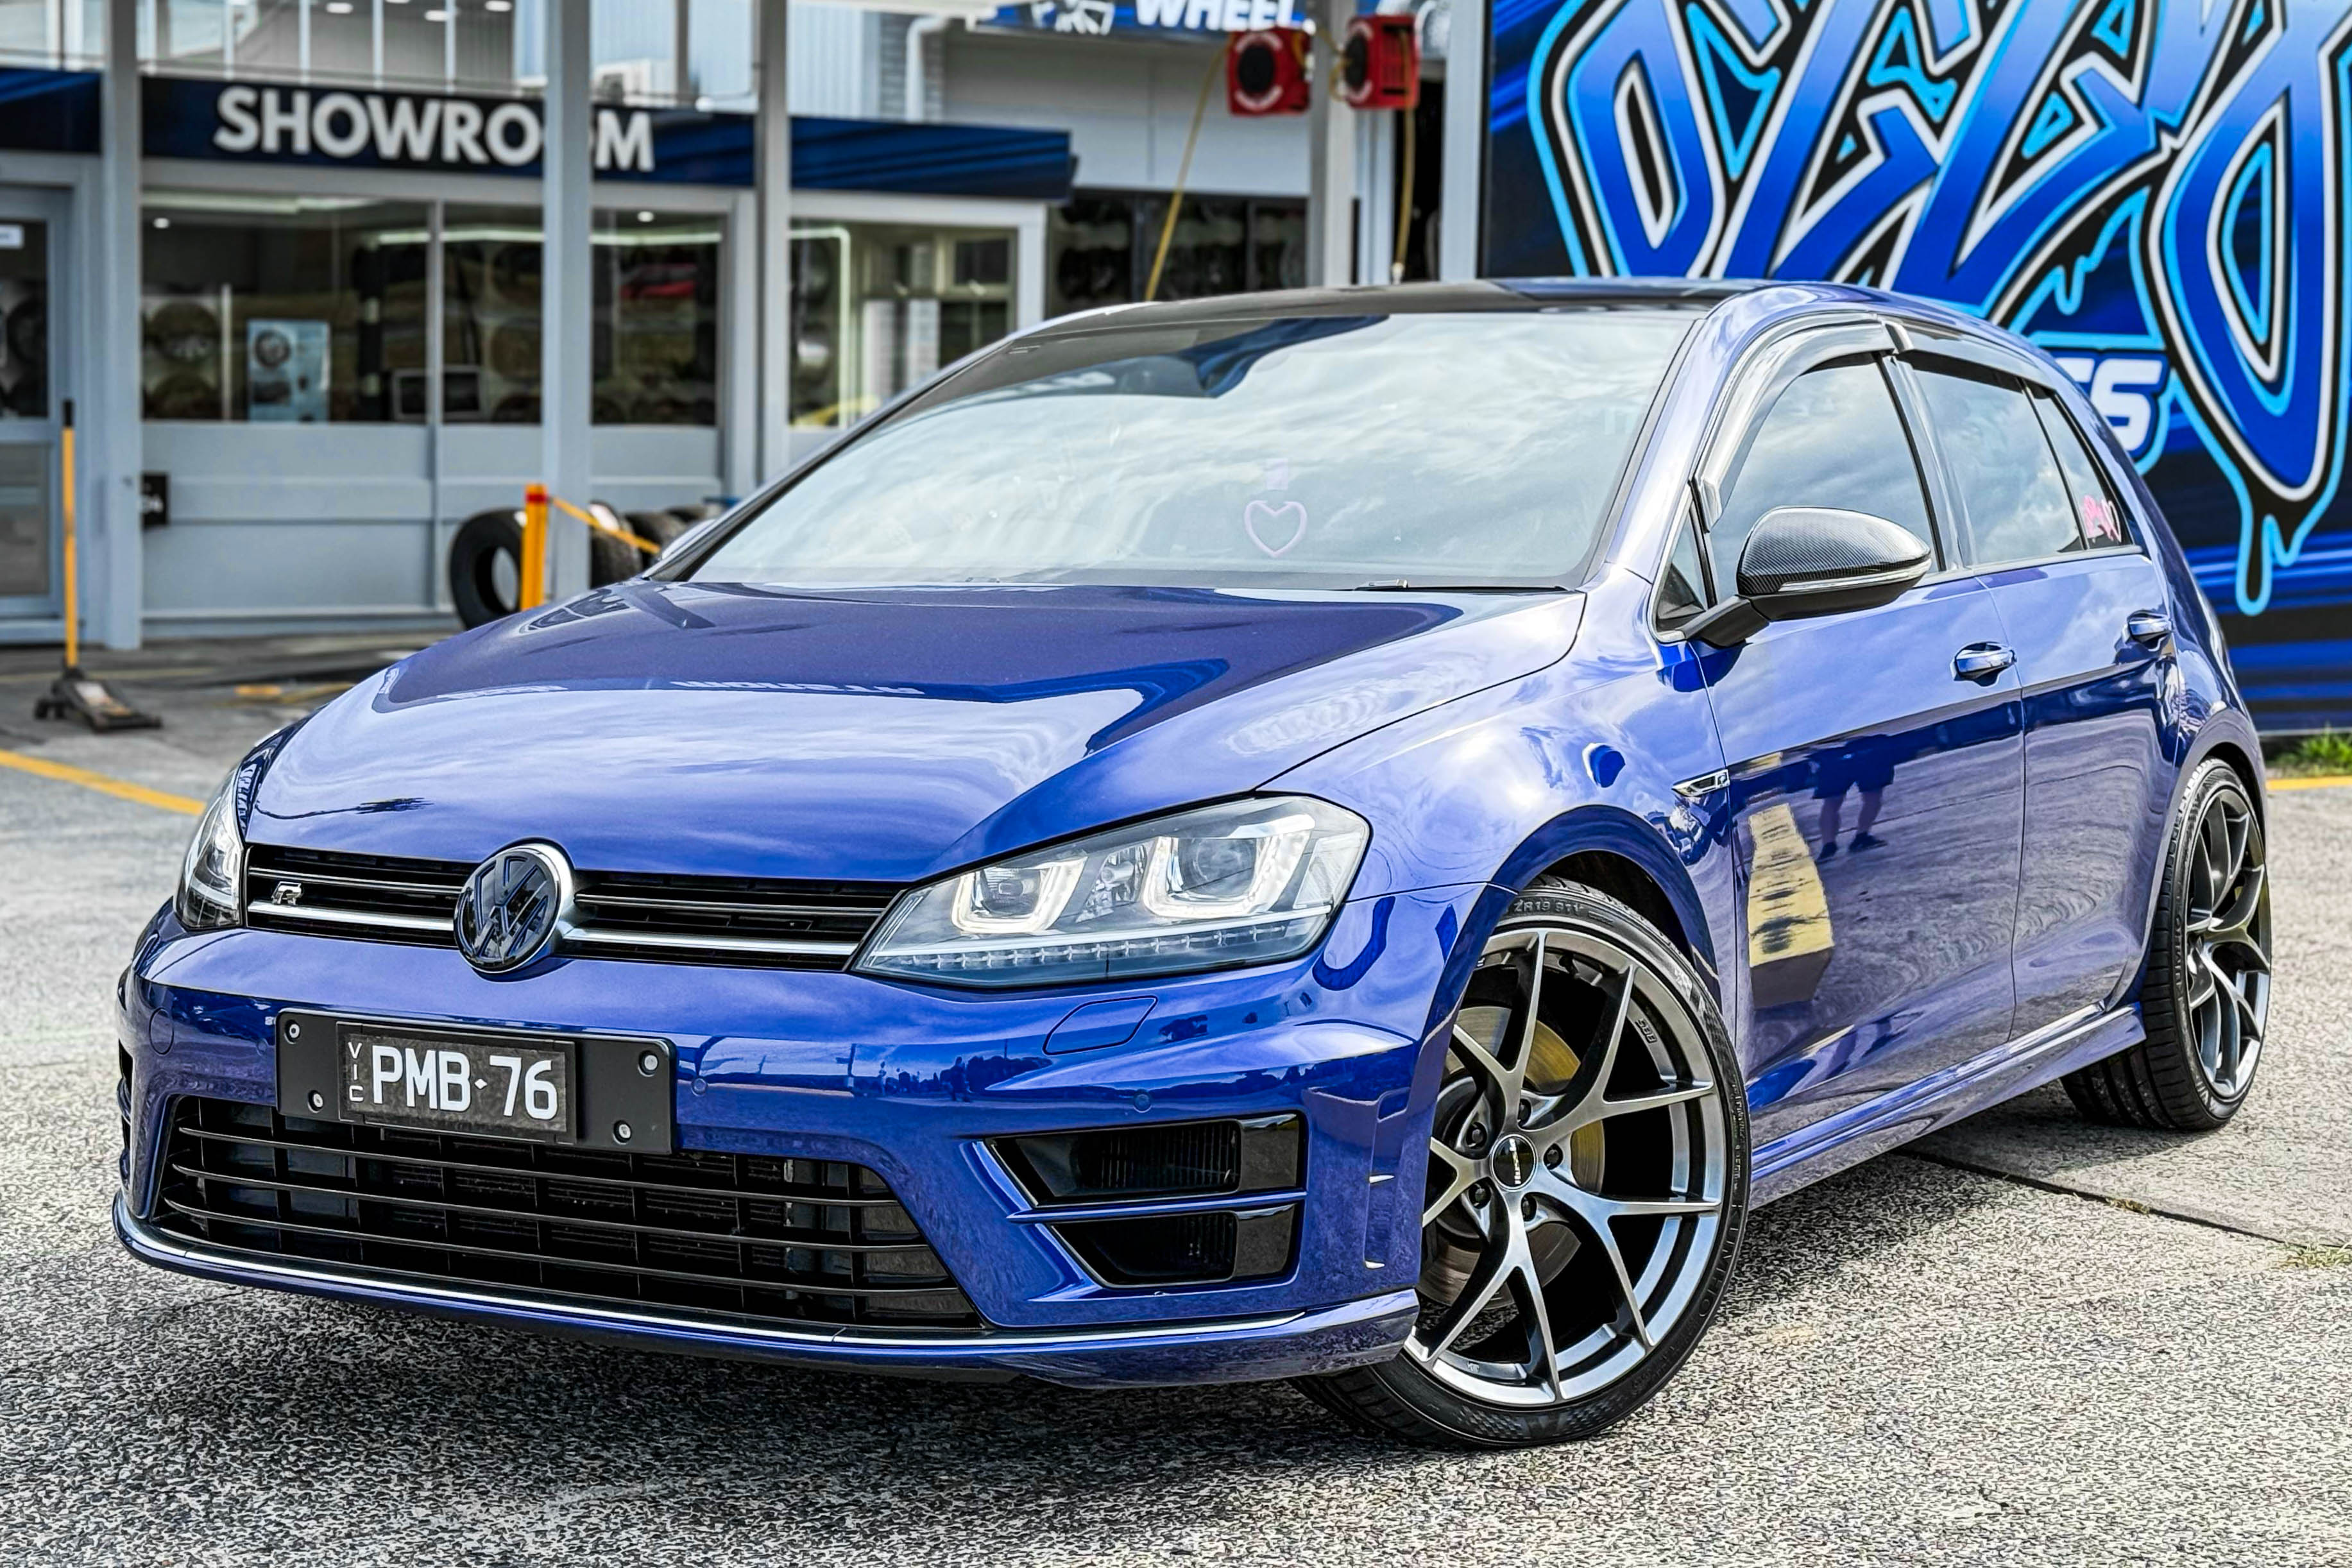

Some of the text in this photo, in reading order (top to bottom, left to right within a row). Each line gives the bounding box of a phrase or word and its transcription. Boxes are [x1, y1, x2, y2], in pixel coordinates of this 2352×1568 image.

[1136, 0, 1301, 31] WHEEL
[214, 85, 655, 171] SHOWROM
[271, 881, 303, 905] R
[347, 1041, 364, 1103] VIC
